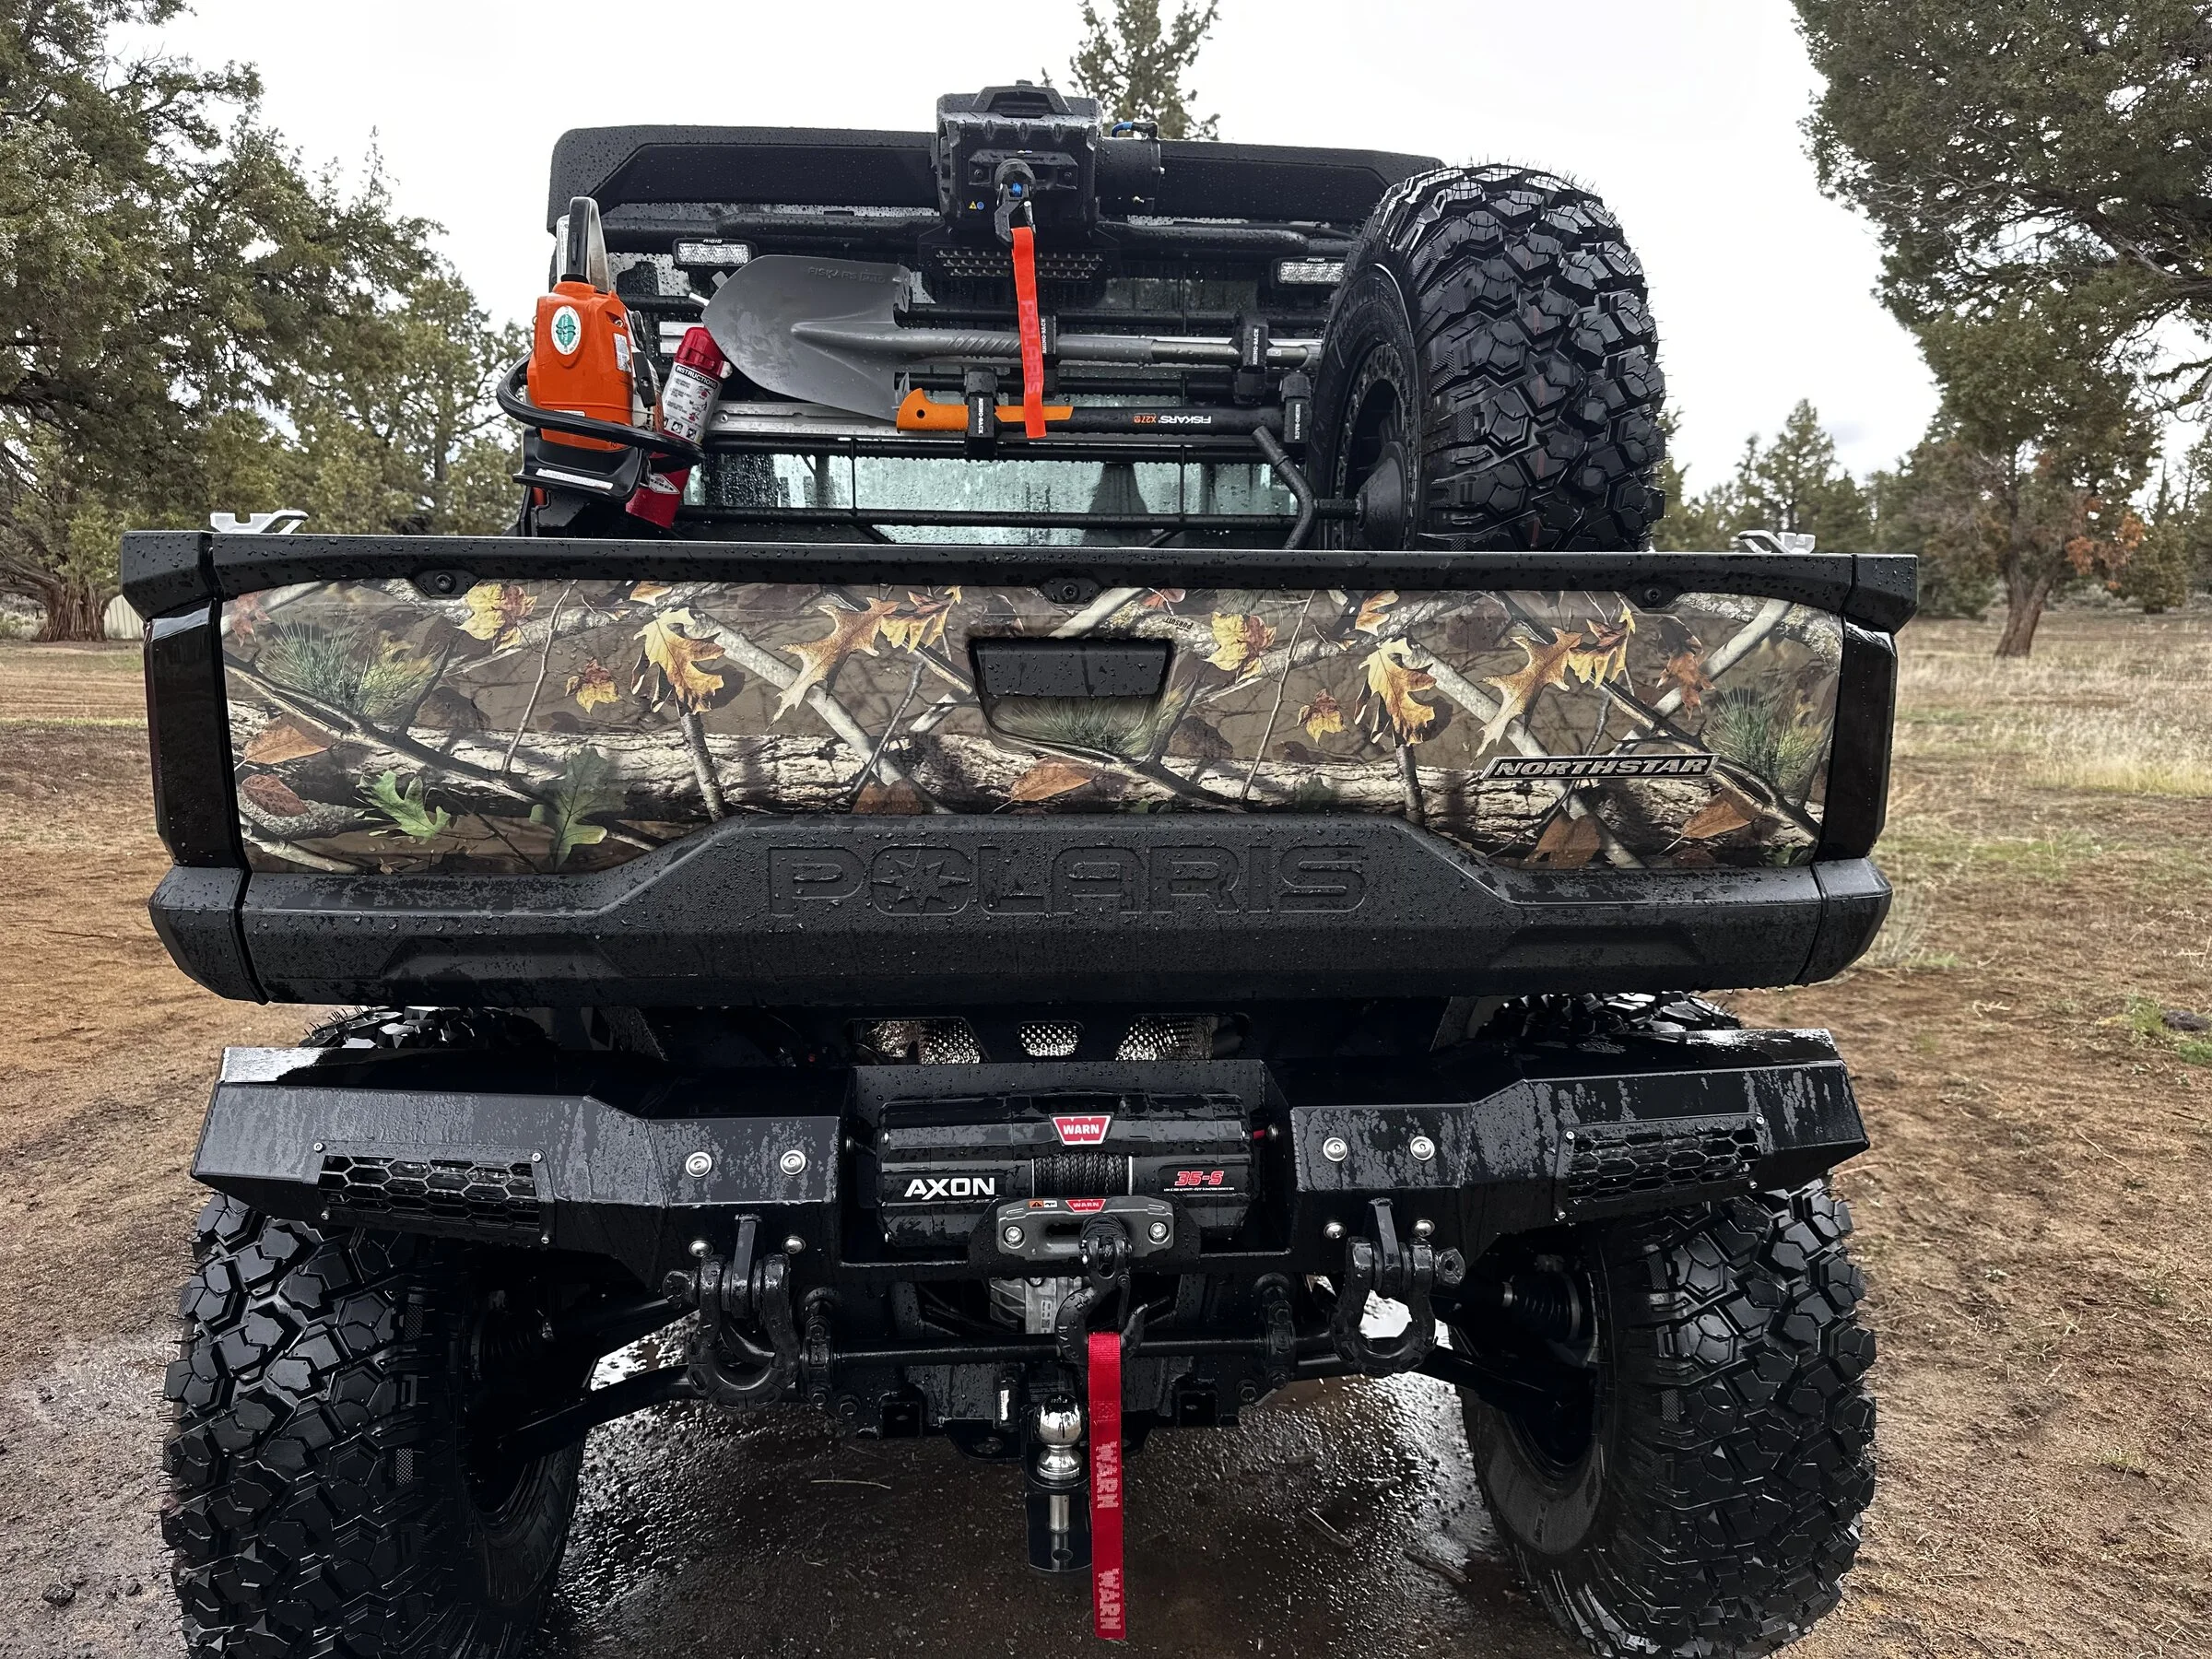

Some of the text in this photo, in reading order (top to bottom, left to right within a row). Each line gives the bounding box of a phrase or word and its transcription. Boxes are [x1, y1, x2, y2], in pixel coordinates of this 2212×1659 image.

[1020, 300, 1041, 395] POLARIS
[676, 365, 718, 388] INSTRUCTIONS
[1158, 415, 1212, 424] FISKARS
[1162, 617, 1194, 630] PURSUIT
[1494, 759, 1709, 776] NORTHSTAR
[768, 843, 1367, 917] POLARIS
[1063, 1124, 1100, 1135] WARN
[903, 1177, 995, 1201] AXON
[1174, 1171, 1225, 1186] 35-S
[1095, 1441, 1119, 1509] WARN
[1098, 1568, 1122, 1630] WARN
